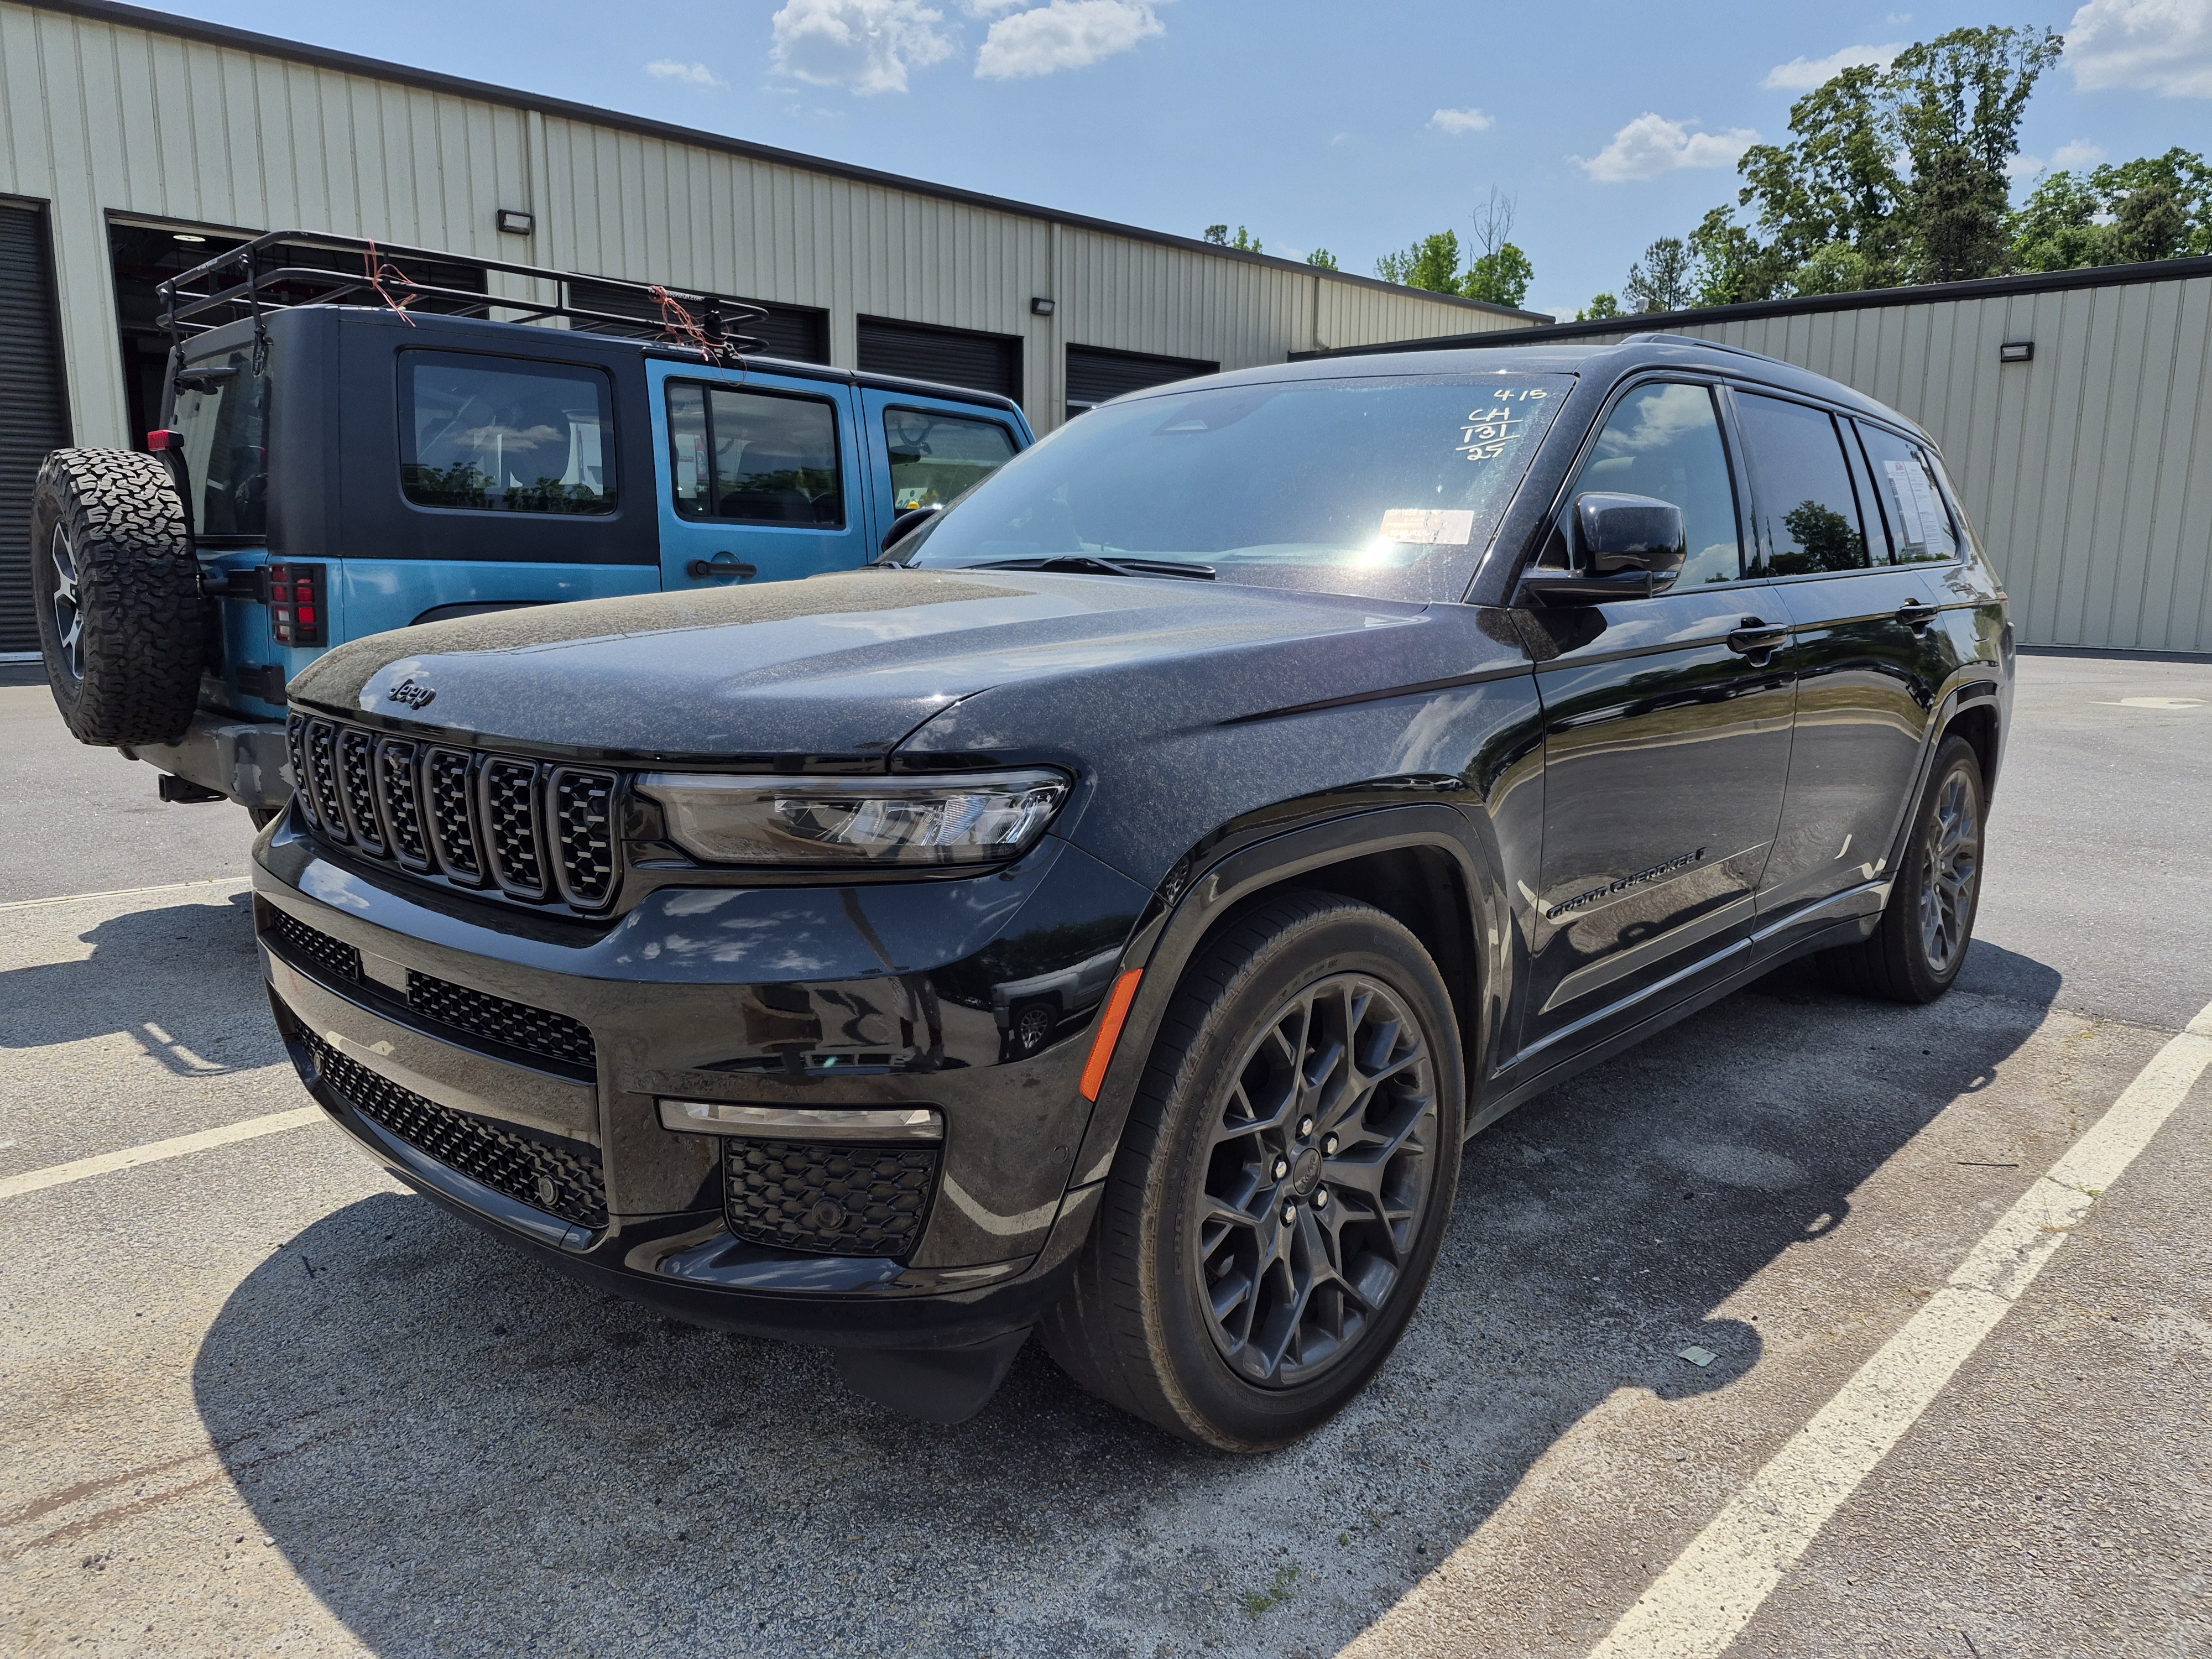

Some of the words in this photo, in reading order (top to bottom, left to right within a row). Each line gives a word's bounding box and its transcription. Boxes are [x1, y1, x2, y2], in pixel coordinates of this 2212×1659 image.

[1468, 408, 1510, 422] CH
[1464, 424, 1506, 444] 131
[1467, 442, 1506, 461] 25
[387, 679, 437, 711] Jeep
[1546, 886, 1608, 920] GRAND
[1610, 852, 1695, 893] CHEROKEE
[1301, 1154, 1316, 1190] Jeep
